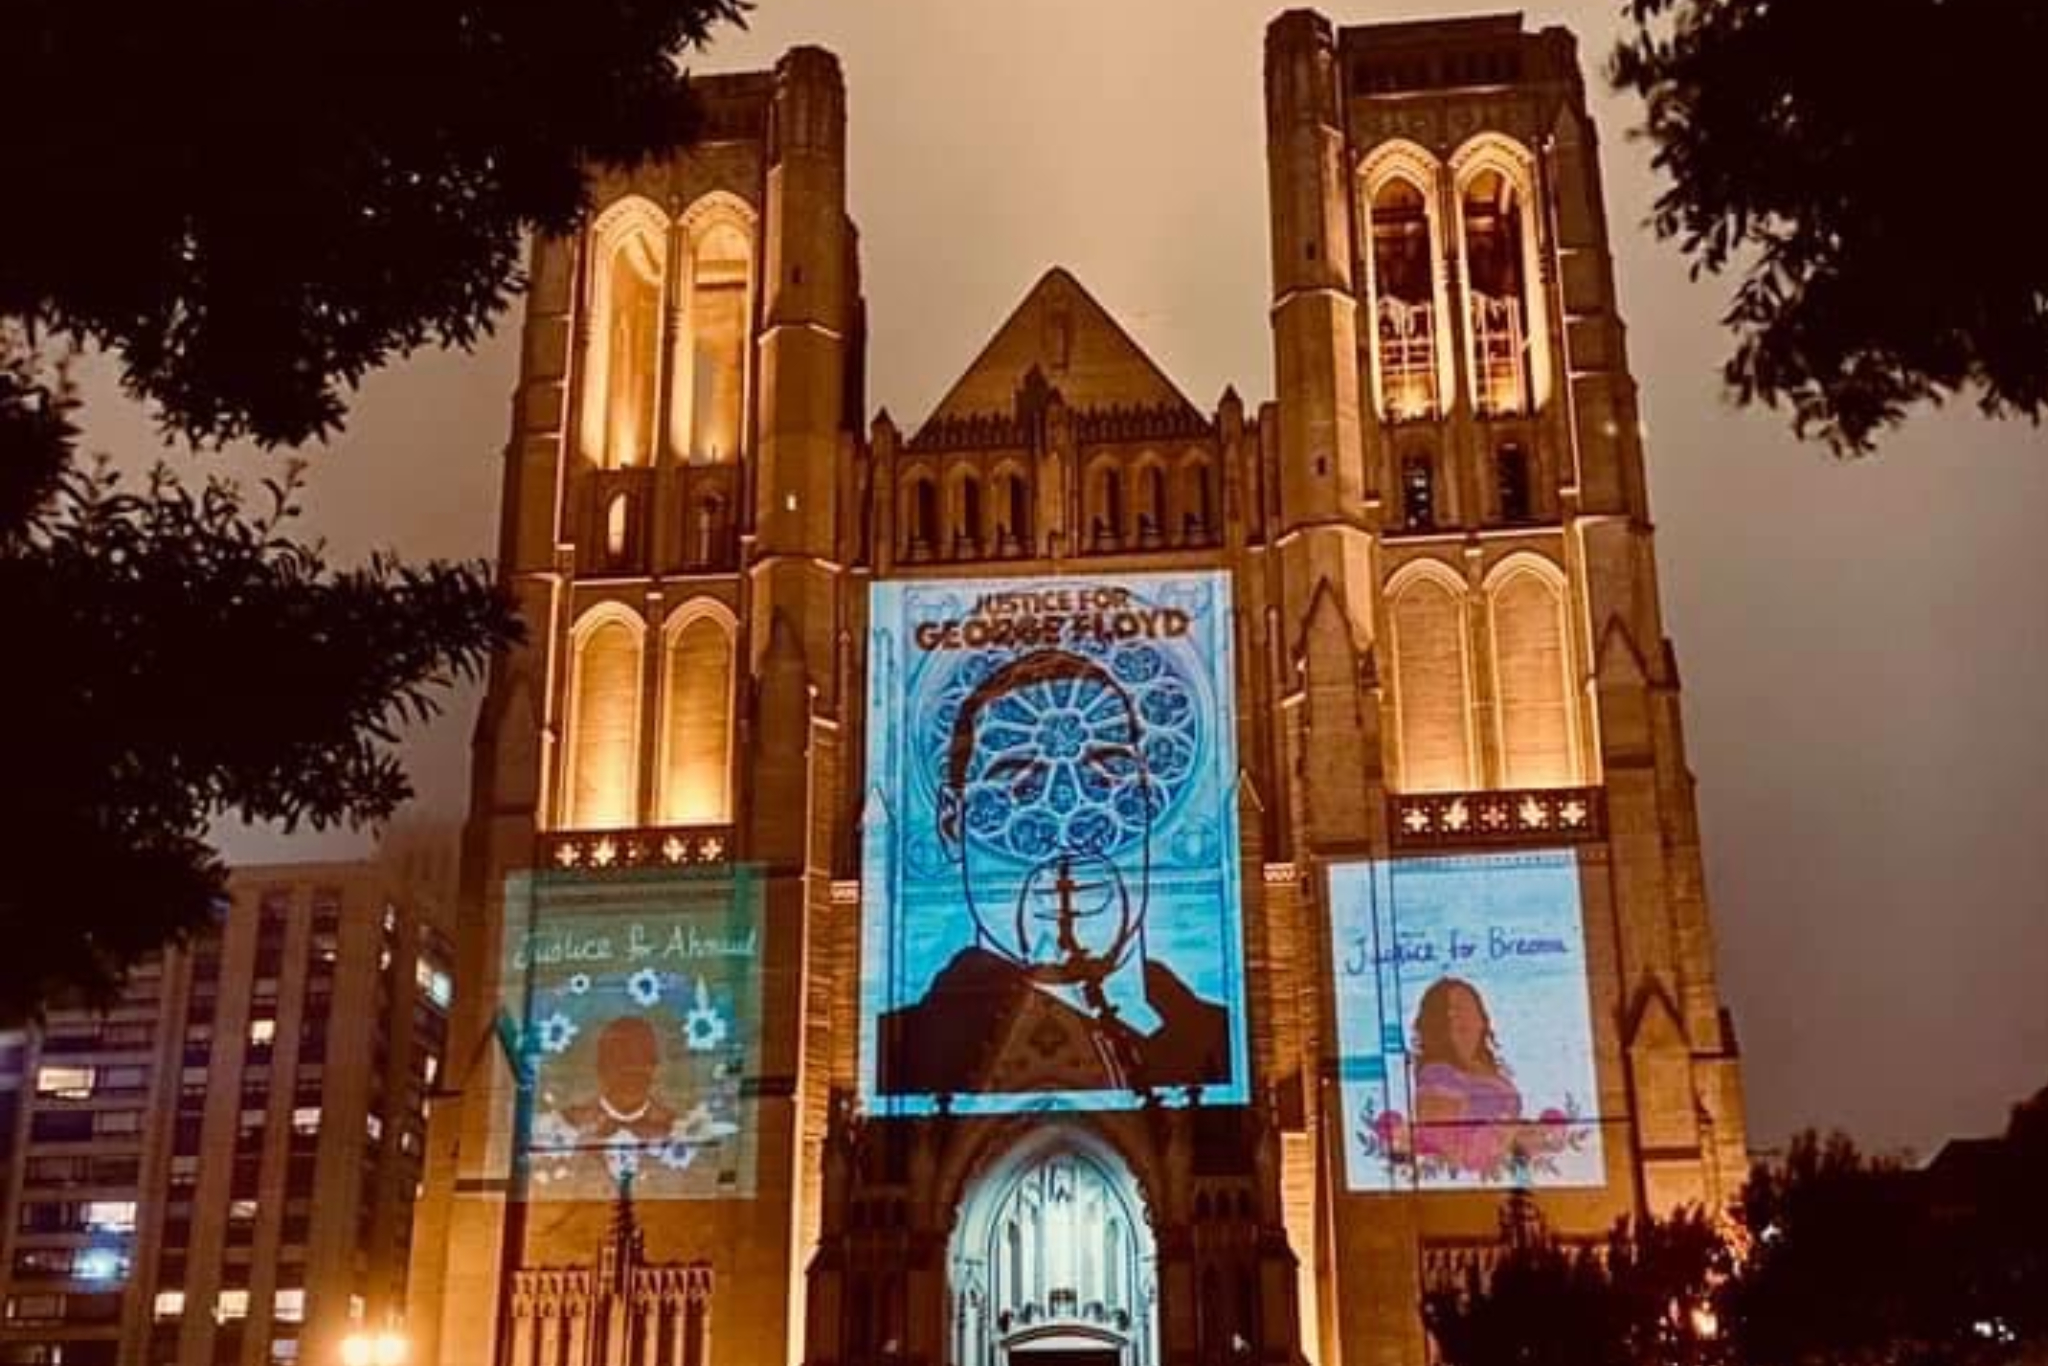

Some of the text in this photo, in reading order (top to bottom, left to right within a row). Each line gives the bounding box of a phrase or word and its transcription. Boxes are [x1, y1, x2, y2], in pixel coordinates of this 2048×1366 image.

[970, 587, 1129, 614] JUSTICE FOR
[915, 608, 1191, 650] GEORGE FLOYD
